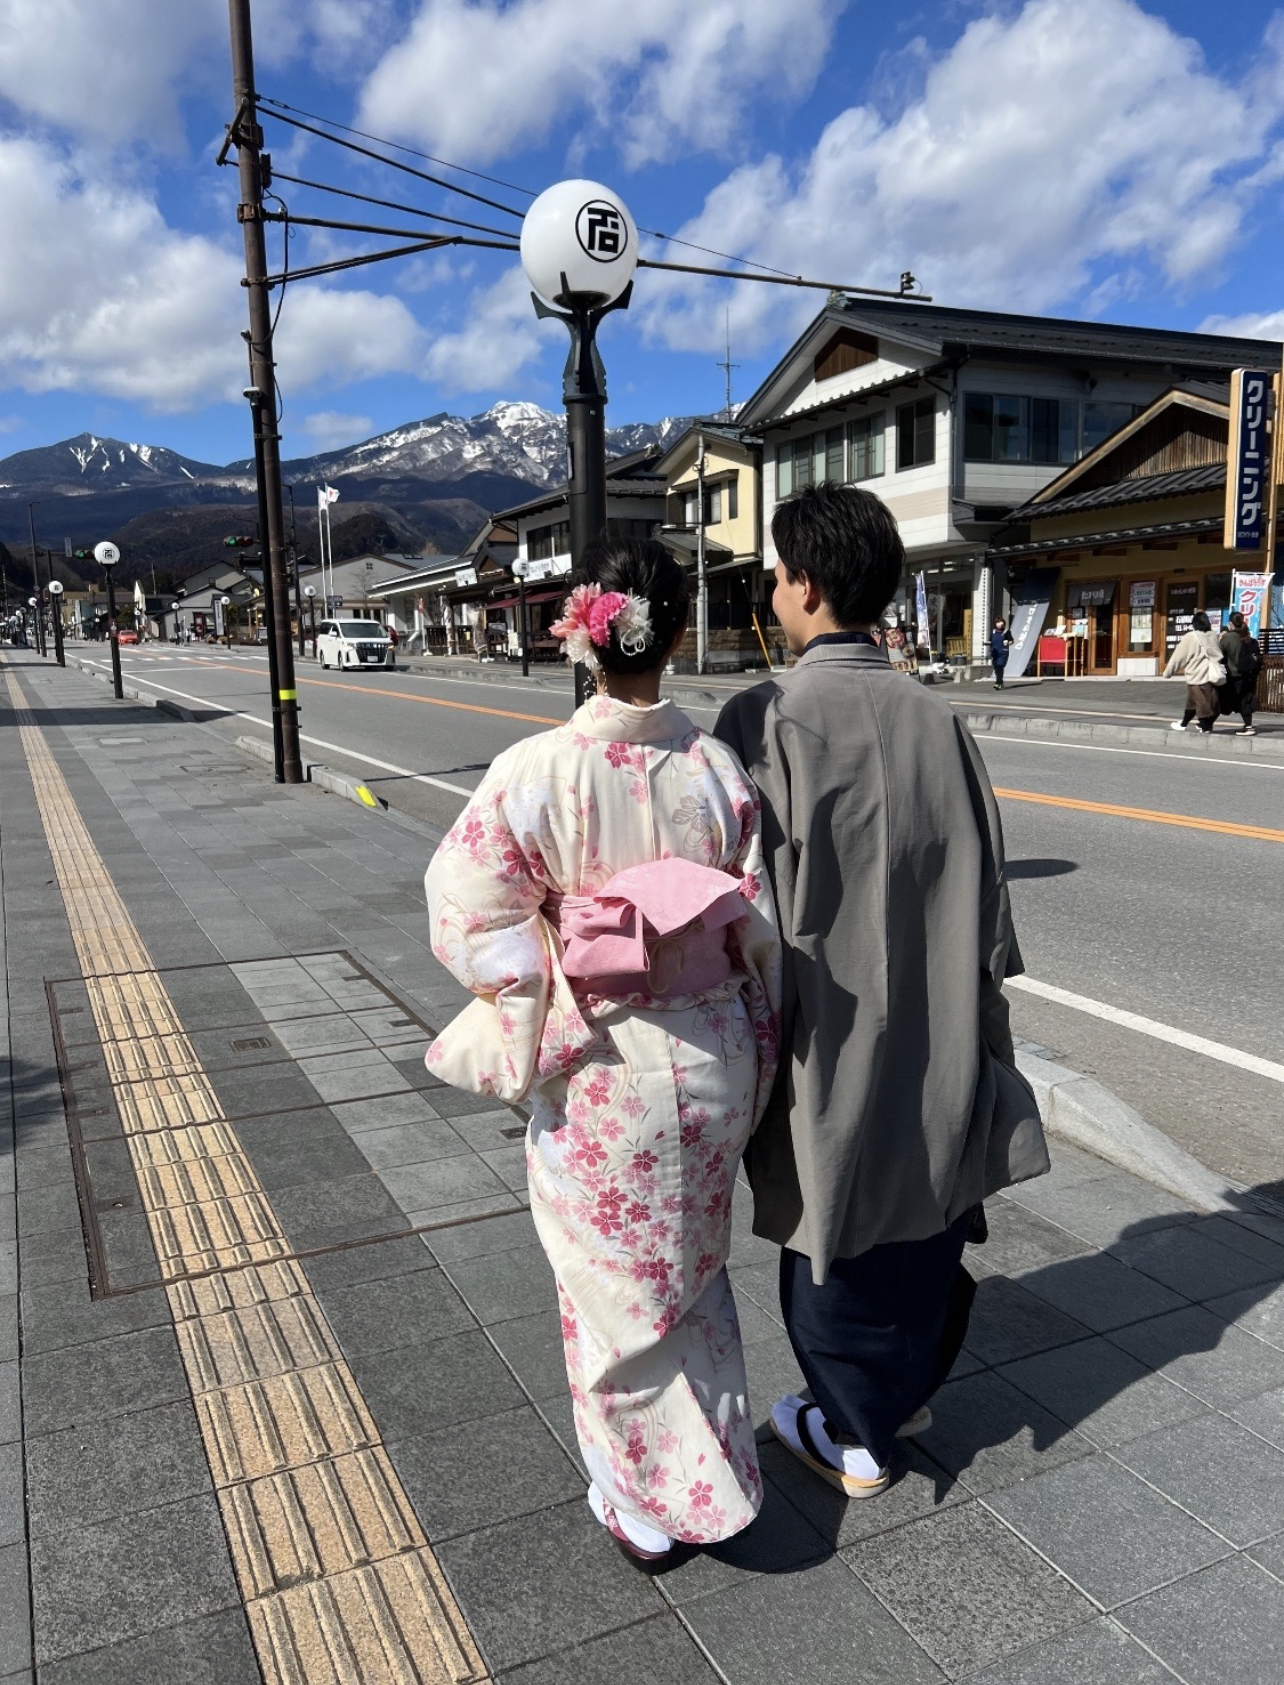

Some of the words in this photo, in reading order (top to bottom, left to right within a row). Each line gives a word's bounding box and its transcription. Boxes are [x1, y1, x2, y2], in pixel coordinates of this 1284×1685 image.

[1241, 380, 1264, 526] クリーニング
